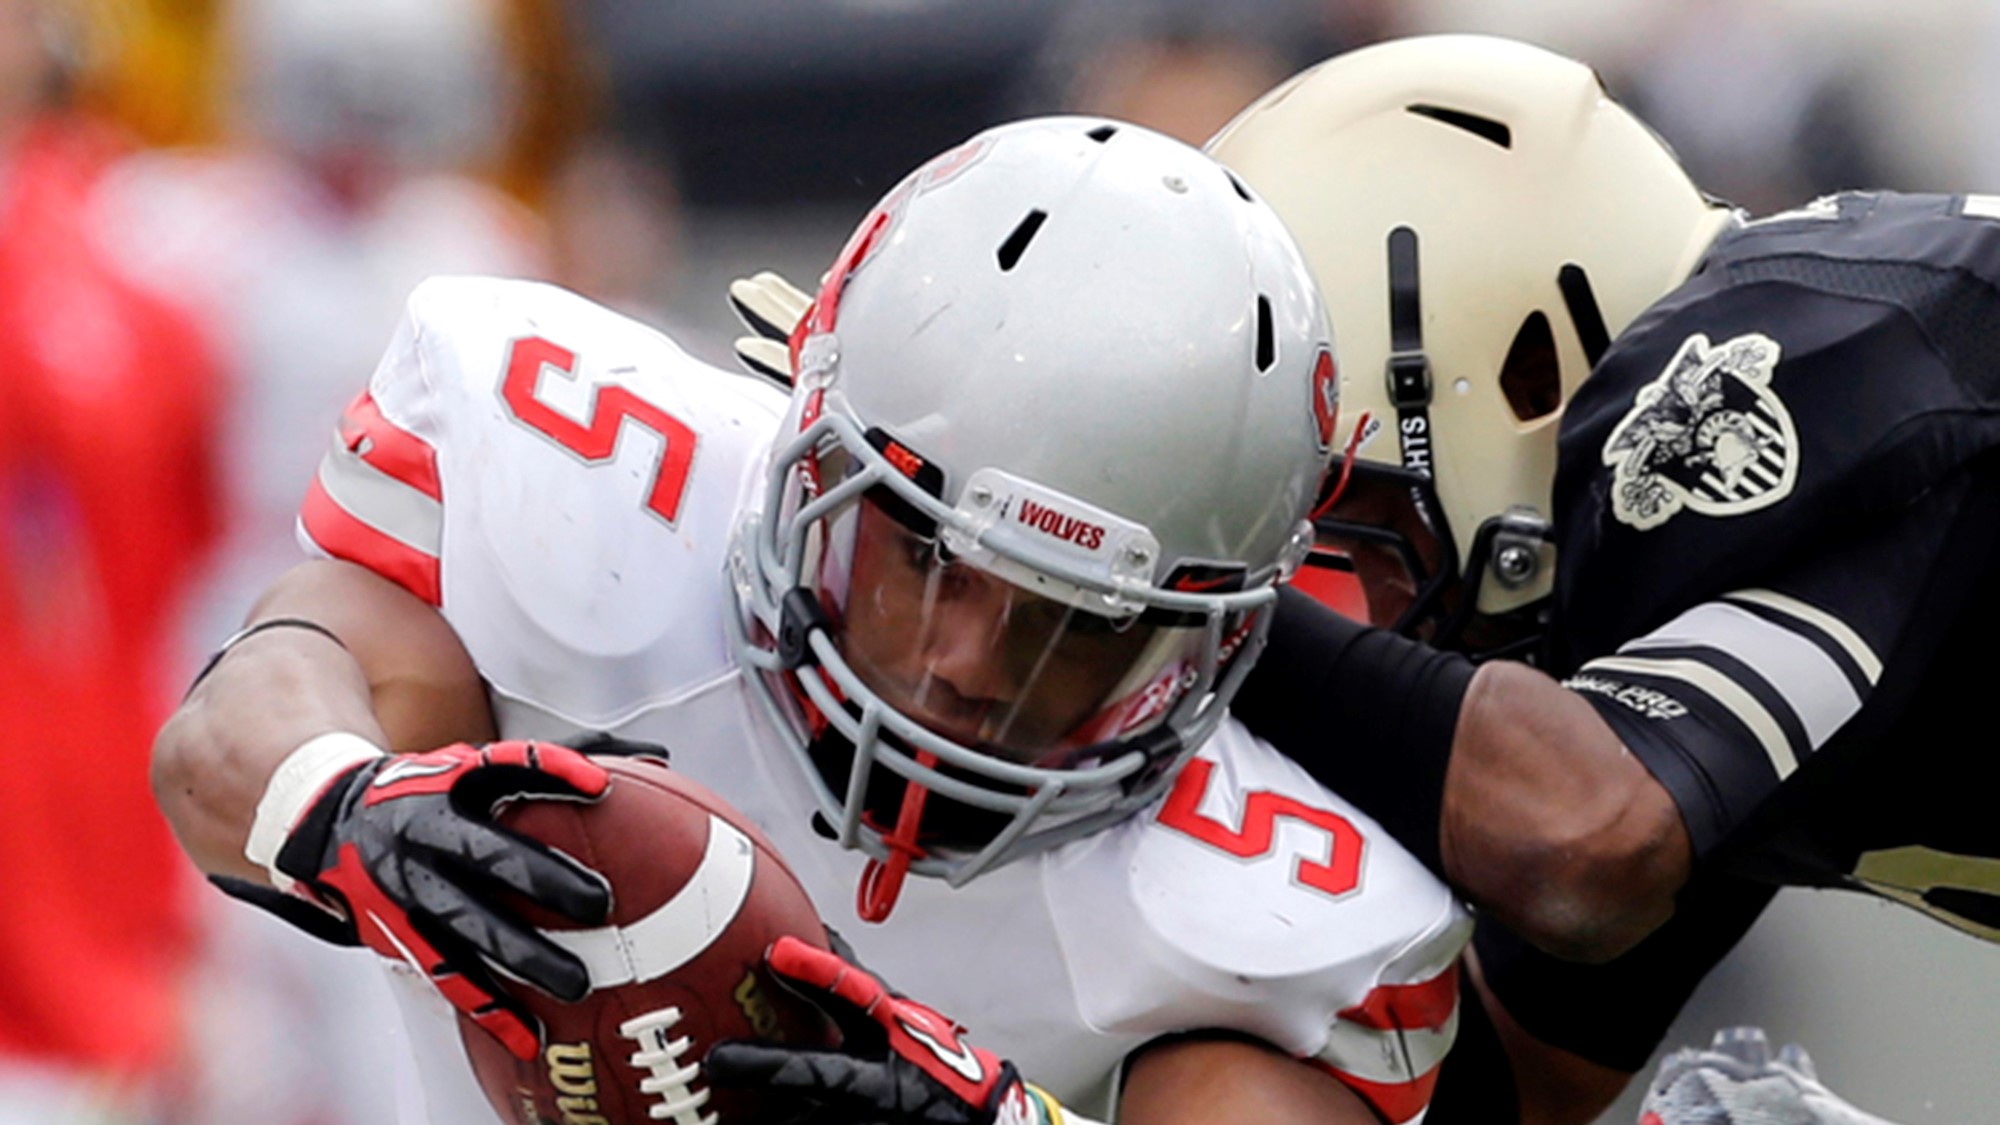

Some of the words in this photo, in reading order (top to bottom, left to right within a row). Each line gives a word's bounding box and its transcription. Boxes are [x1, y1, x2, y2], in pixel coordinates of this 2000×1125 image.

[496, 334, 701, 531] 5
[1018, 498, 1105, 550] WOLVES
[1150, 756, 1370, 903] 5
